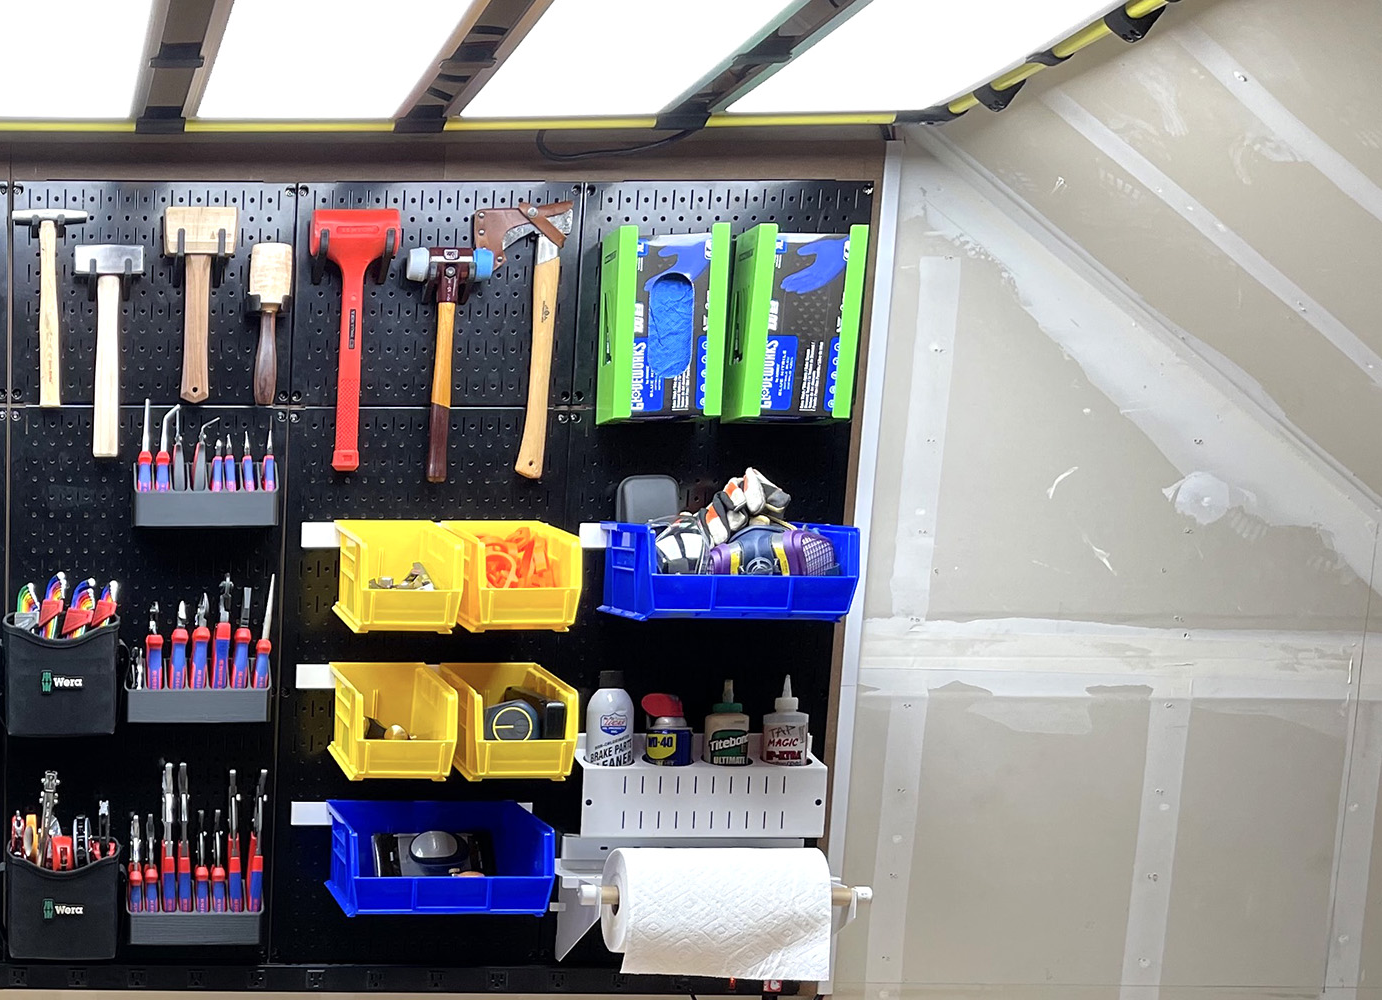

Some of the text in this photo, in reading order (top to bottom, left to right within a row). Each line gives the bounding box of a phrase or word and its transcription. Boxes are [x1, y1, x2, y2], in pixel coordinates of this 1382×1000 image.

[52, 677, 83, 688] Wera
[769, 724, 796, 739] TAP
[767, 738, 799, 748] MAGIC
[590, 738, 633, 763] BRAKE PARTS
[54, 905, 84, 915] Wera
